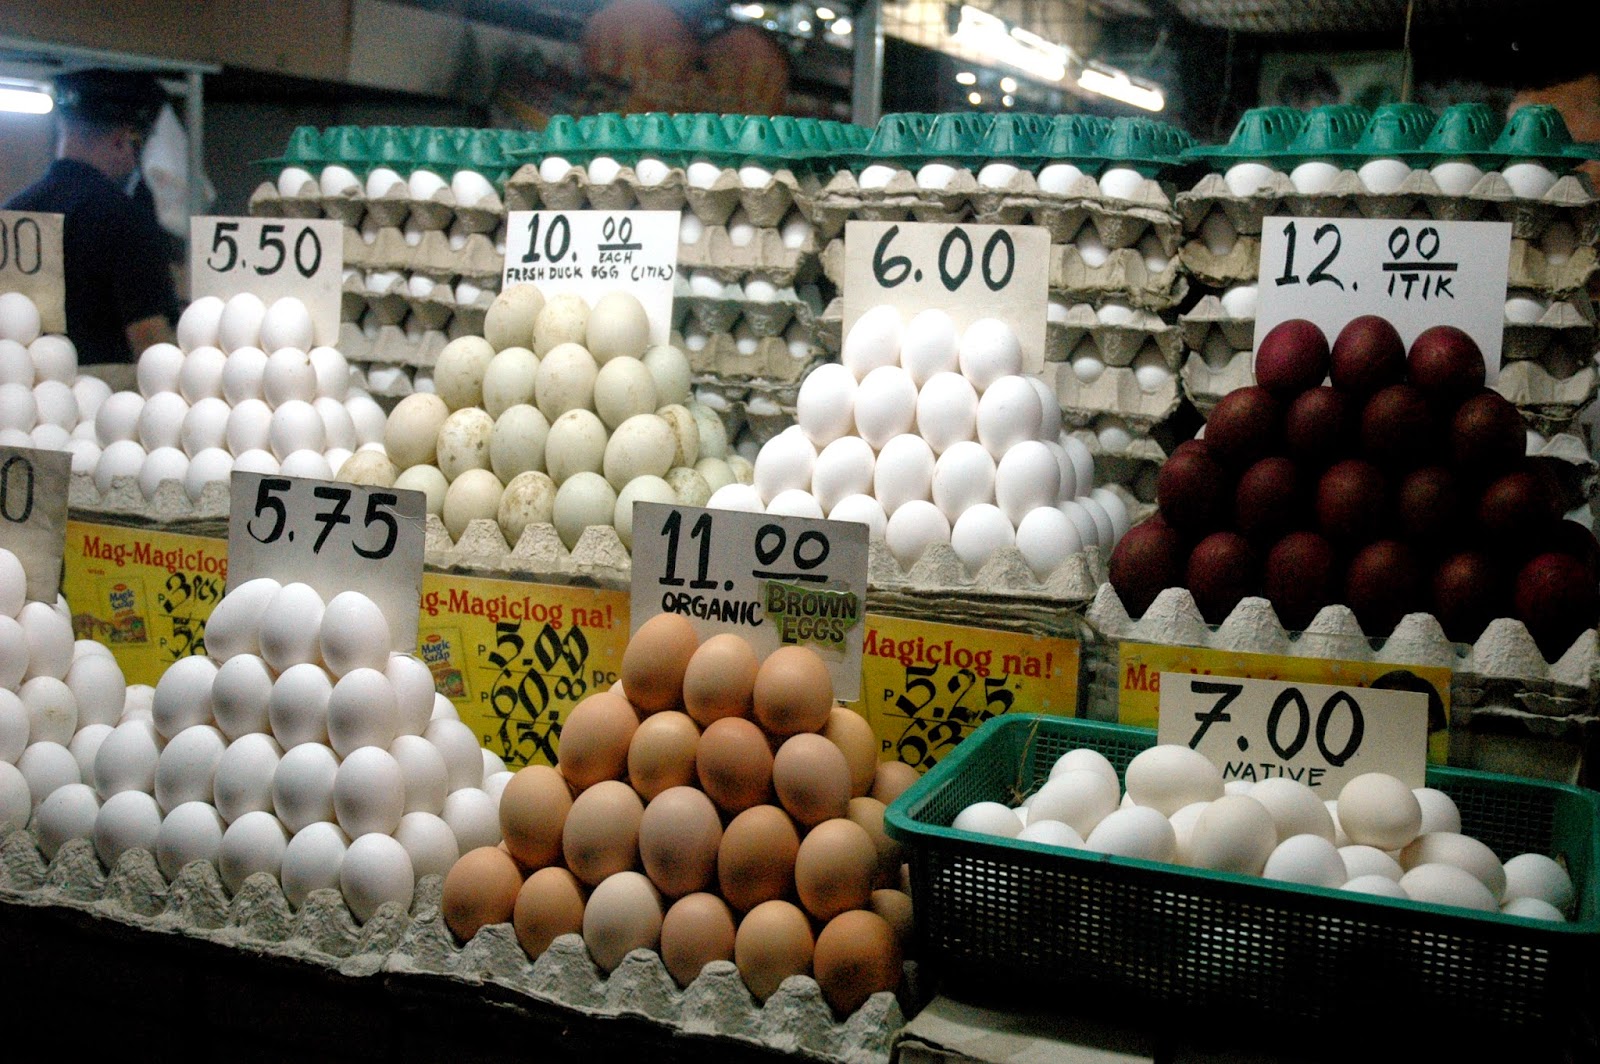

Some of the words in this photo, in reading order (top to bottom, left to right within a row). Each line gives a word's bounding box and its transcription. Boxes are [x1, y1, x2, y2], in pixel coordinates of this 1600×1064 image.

[207, 222, 322, 279] 5.50
[599, 251, 632, 264] EACH
[873, 225, 1015, 292] 6.00
[507, 267, 545, 283] FRESH
[550, 265, 583, 279] DUCK
[1388, 273, 1454, 300] ITIK
[247, 479, 398, 560] 5.75
[571, 604, 613, 629] na!
[661, 591, 764, 627] ORGANIC
[767, 583, 857, 619] BROWN
[781, 616, 845, 644] EGGS
[1002, 651, 1053, 679] na!
[884, 688, 894, 702] P
[895, 664, 1016, 724] 5.25
[1188, 680, 1365, 767] 7.00
[882, 740, 892, 752] P
[1222, 761, 1327, 787] NATIVE
